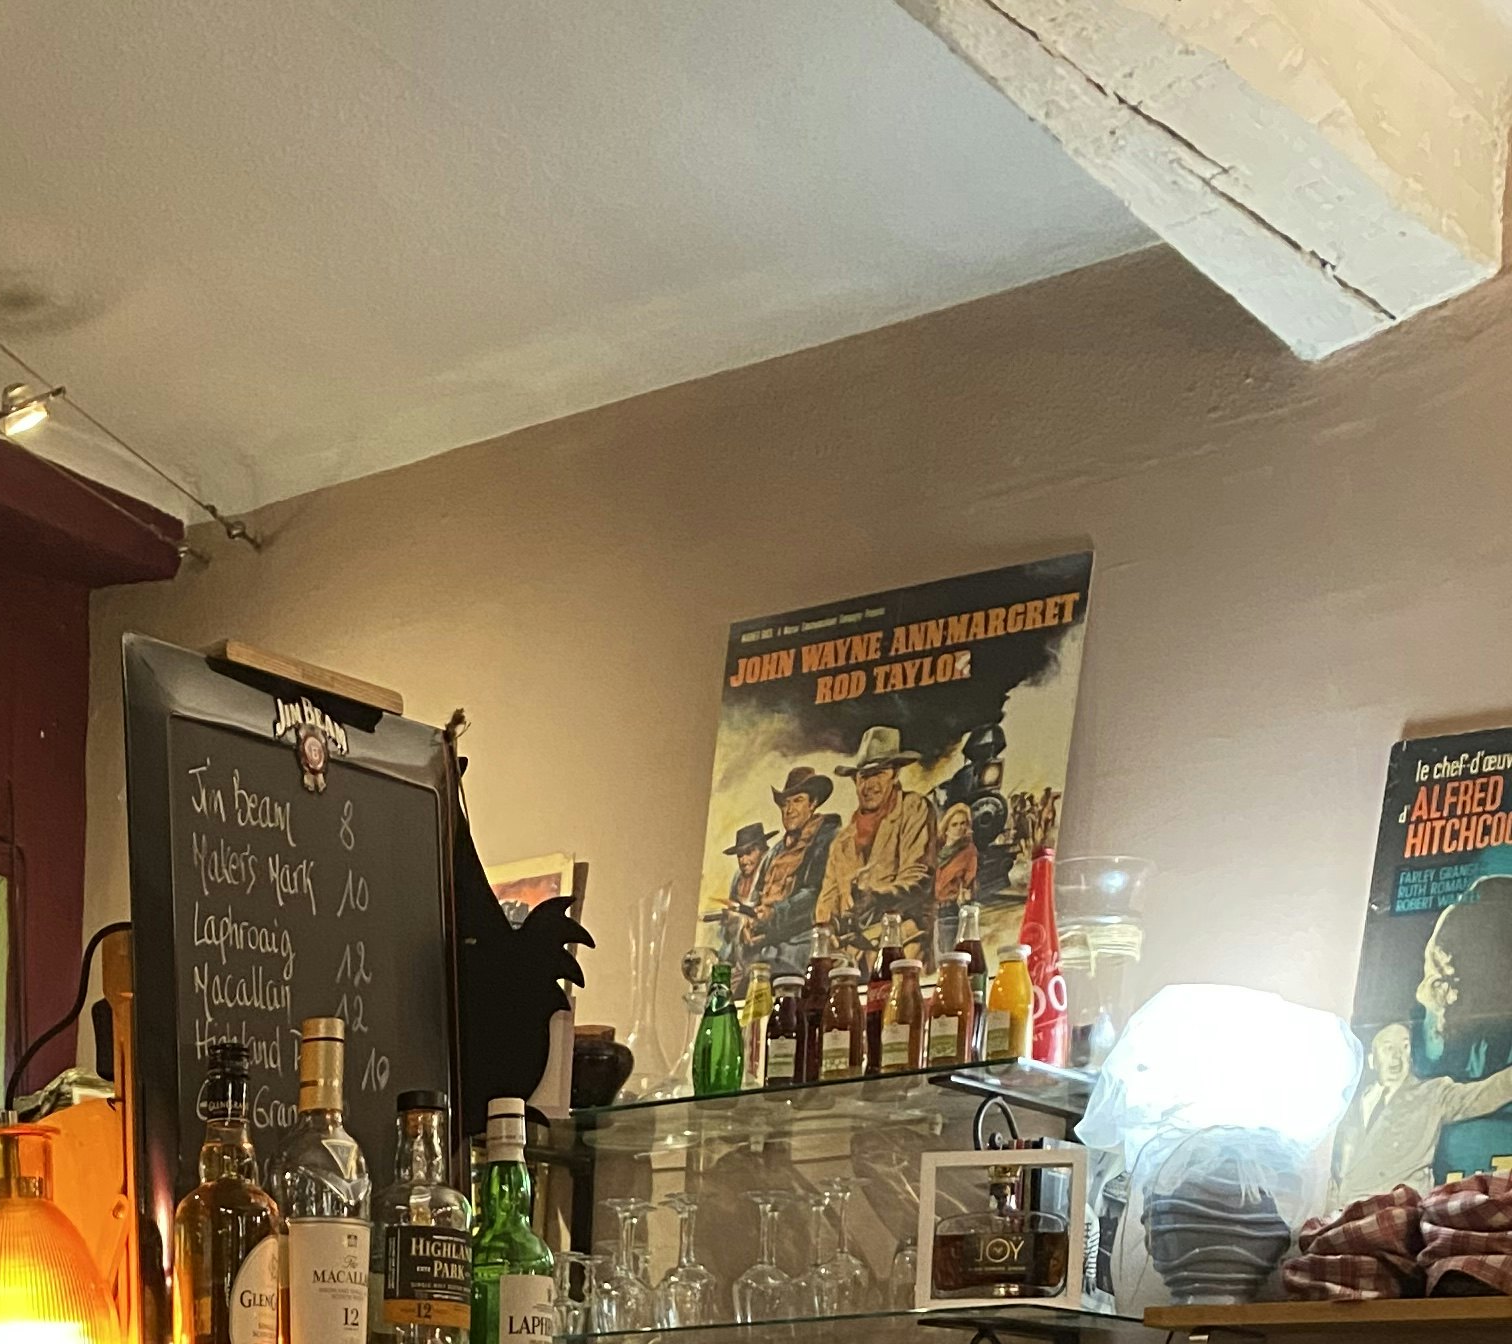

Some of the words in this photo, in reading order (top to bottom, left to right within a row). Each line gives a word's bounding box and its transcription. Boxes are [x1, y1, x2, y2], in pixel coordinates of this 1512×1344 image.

[730, 649, 795, 688] JOHN
[801, 630, 884, 673] WAYNE
[815, 676, 867, 705] ROD
[874, 650, 972, 694] TAYLOR
[275, 698, 303, 737] JIM
[1415, 759, 1430, 782] le
[188, 757, 225, 822] Jim
[233, 769, 296, 847] Beam
[340, 800, 355, 850] 8
[1411, 775, 1504, 822] ALFRED
[192, 832, 257, 896] Maker's
[268, 853, 316, 915] Mark
[337, 869, 369, 917] 10
[1397, 883, 1428, 899] RUTH
[1395, 895, 1434, 912] ROBERT
[194, 901, 296, 980] Laphroaig
[335, 941, 372, 987] 12
[194, 962, 292, 1022] Macallan
[334, 993, 368, 1032] 12
[361, 1048, 390, 1091] 10
[253, 1085, 298, 1128] Gran
[433, 1260, 465, 1280] PARK
[342, 1307, 360, 1327] 12
[416, 1302, 432, 1320] 12
